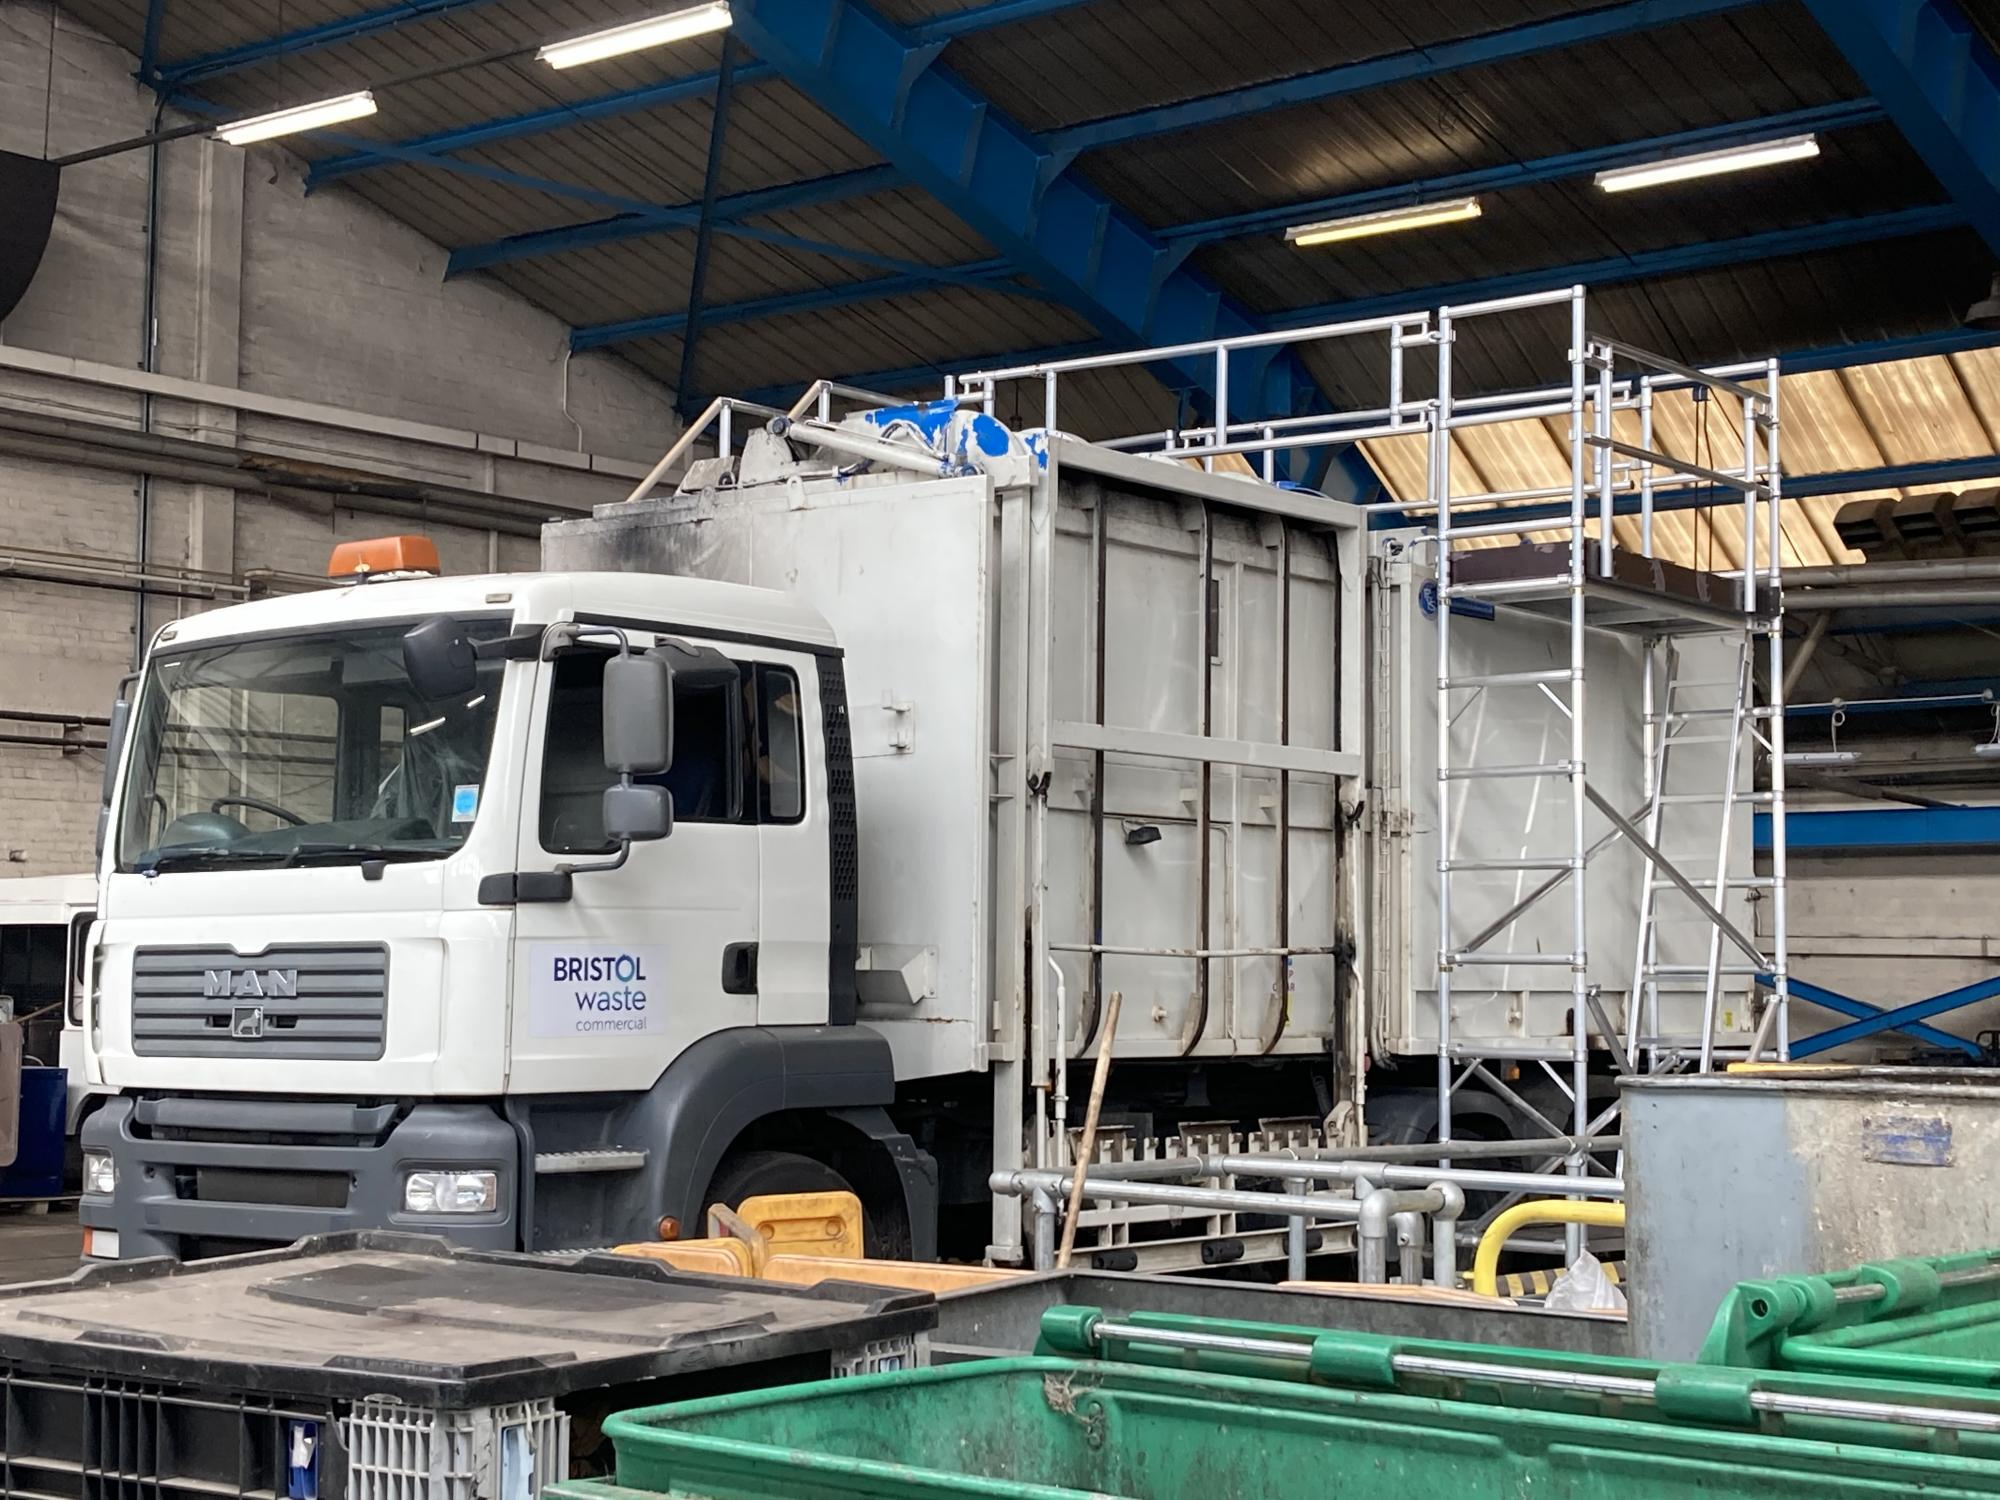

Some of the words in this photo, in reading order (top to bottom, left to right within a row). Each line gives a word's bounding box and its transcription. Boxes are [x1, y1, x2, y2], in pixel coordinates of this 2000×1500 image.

[553, 954, 646, 983] BRISTOL
[203, 969, 298, 996] MAN
[575, 986, 647, 1011] waste
[575, 1016, 647, 1032] commercial
